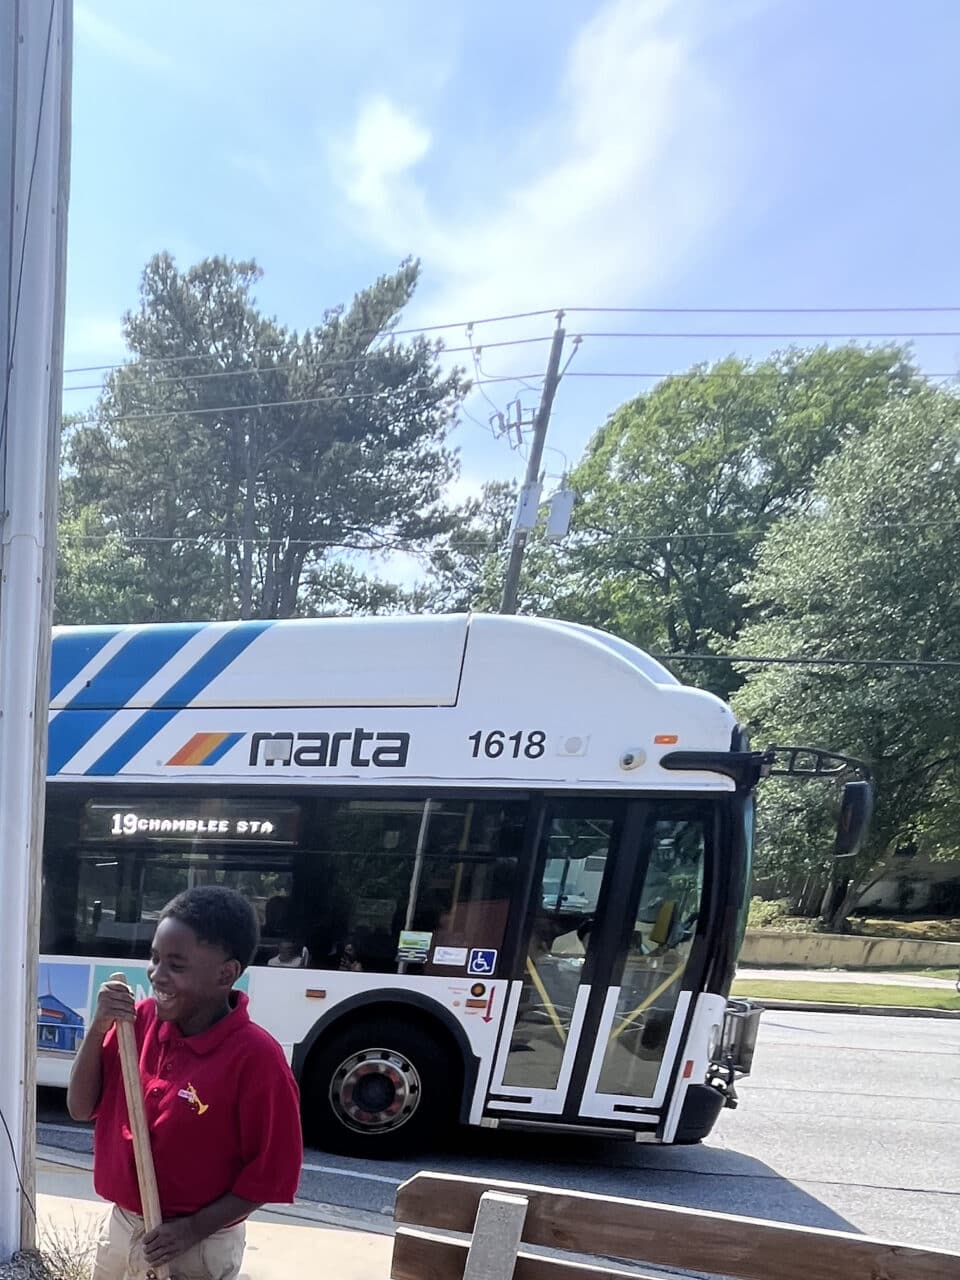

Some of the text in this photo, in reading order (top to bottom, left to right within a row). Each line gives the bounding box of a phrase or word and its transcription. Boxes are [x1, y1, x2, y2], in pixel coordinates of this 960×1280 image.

[249, 728, 410, 767] marta
[468, 730, 546, 759] 1618
[111, 813, 273, 835] 19 CHAMBLEE STA
